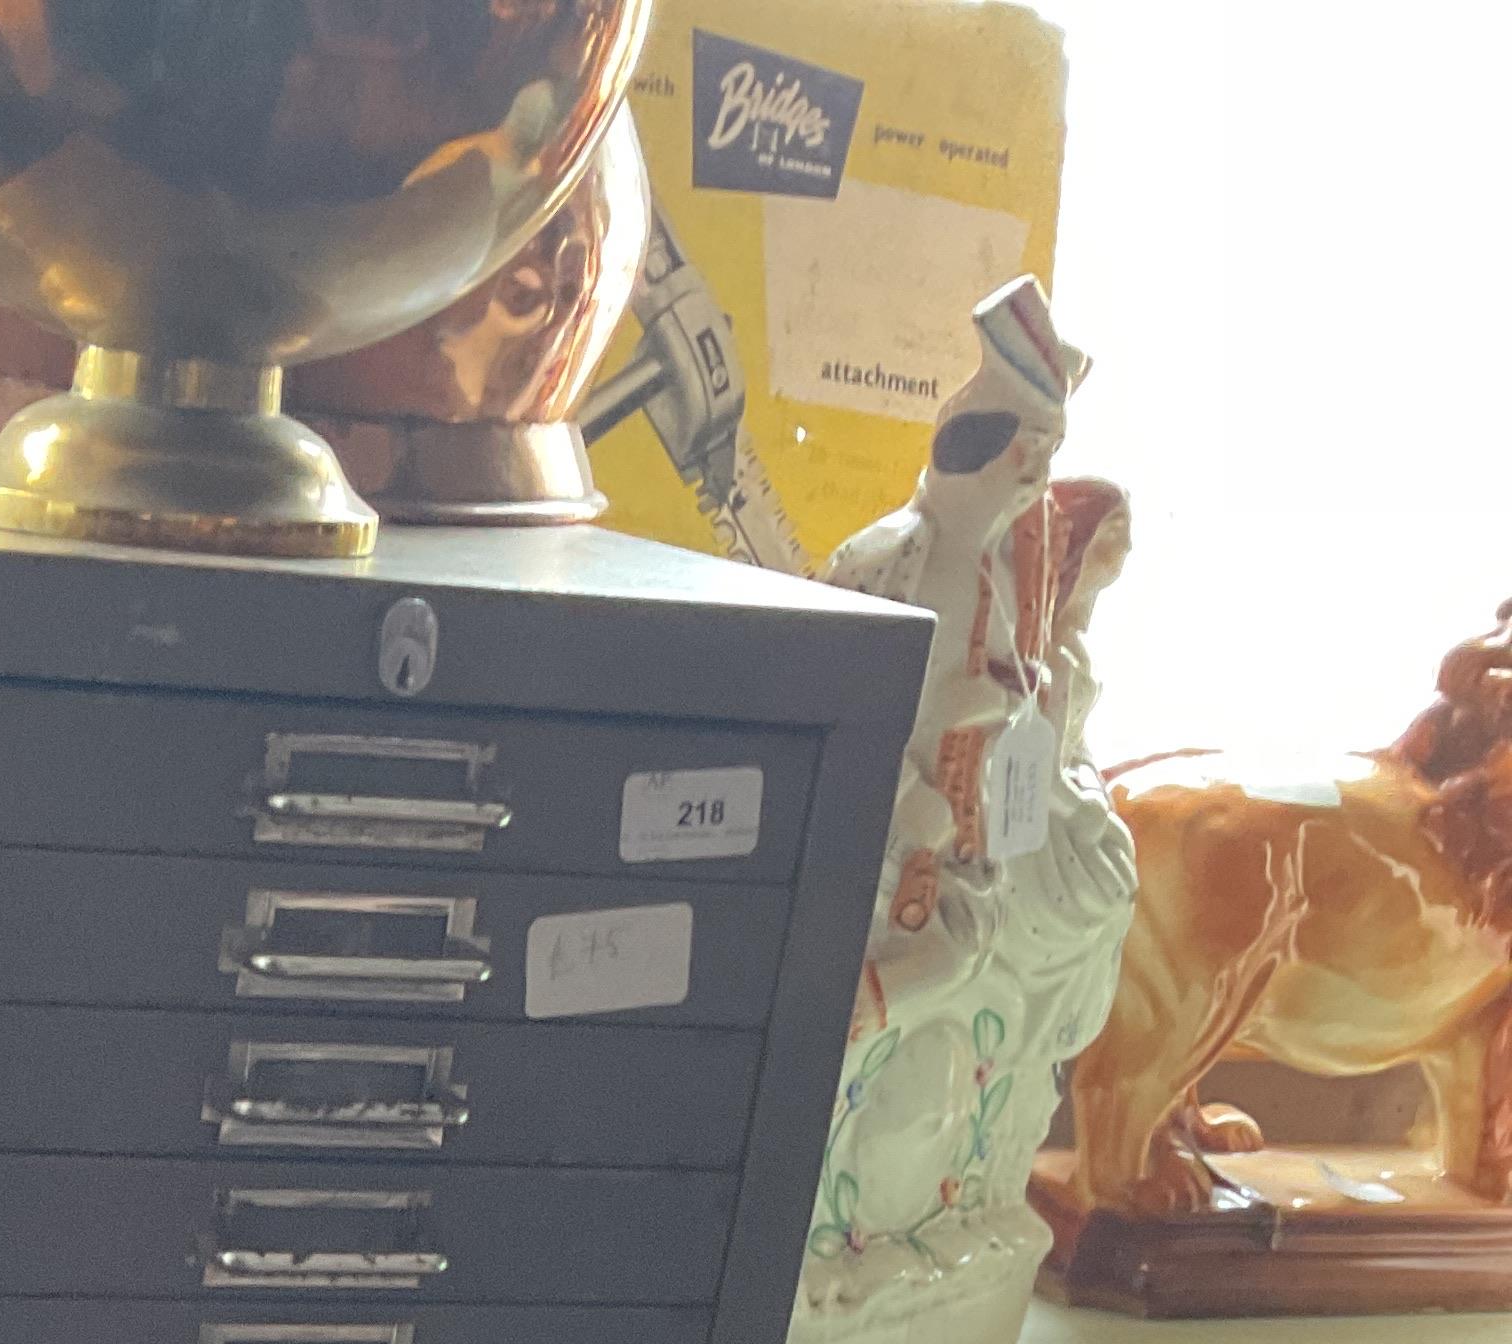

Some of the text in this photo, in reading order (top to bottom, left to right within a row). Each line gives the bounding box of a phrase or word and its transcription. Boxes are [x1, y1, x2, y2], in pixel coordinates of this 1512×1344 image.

[633, 73, 675, 97] with
[708, 61, 831, 150] Bridges
[874, 124, 1009, 170] power operated
[821, 359, 938, 399] attachment
[677, 800, 725, 826] 218
